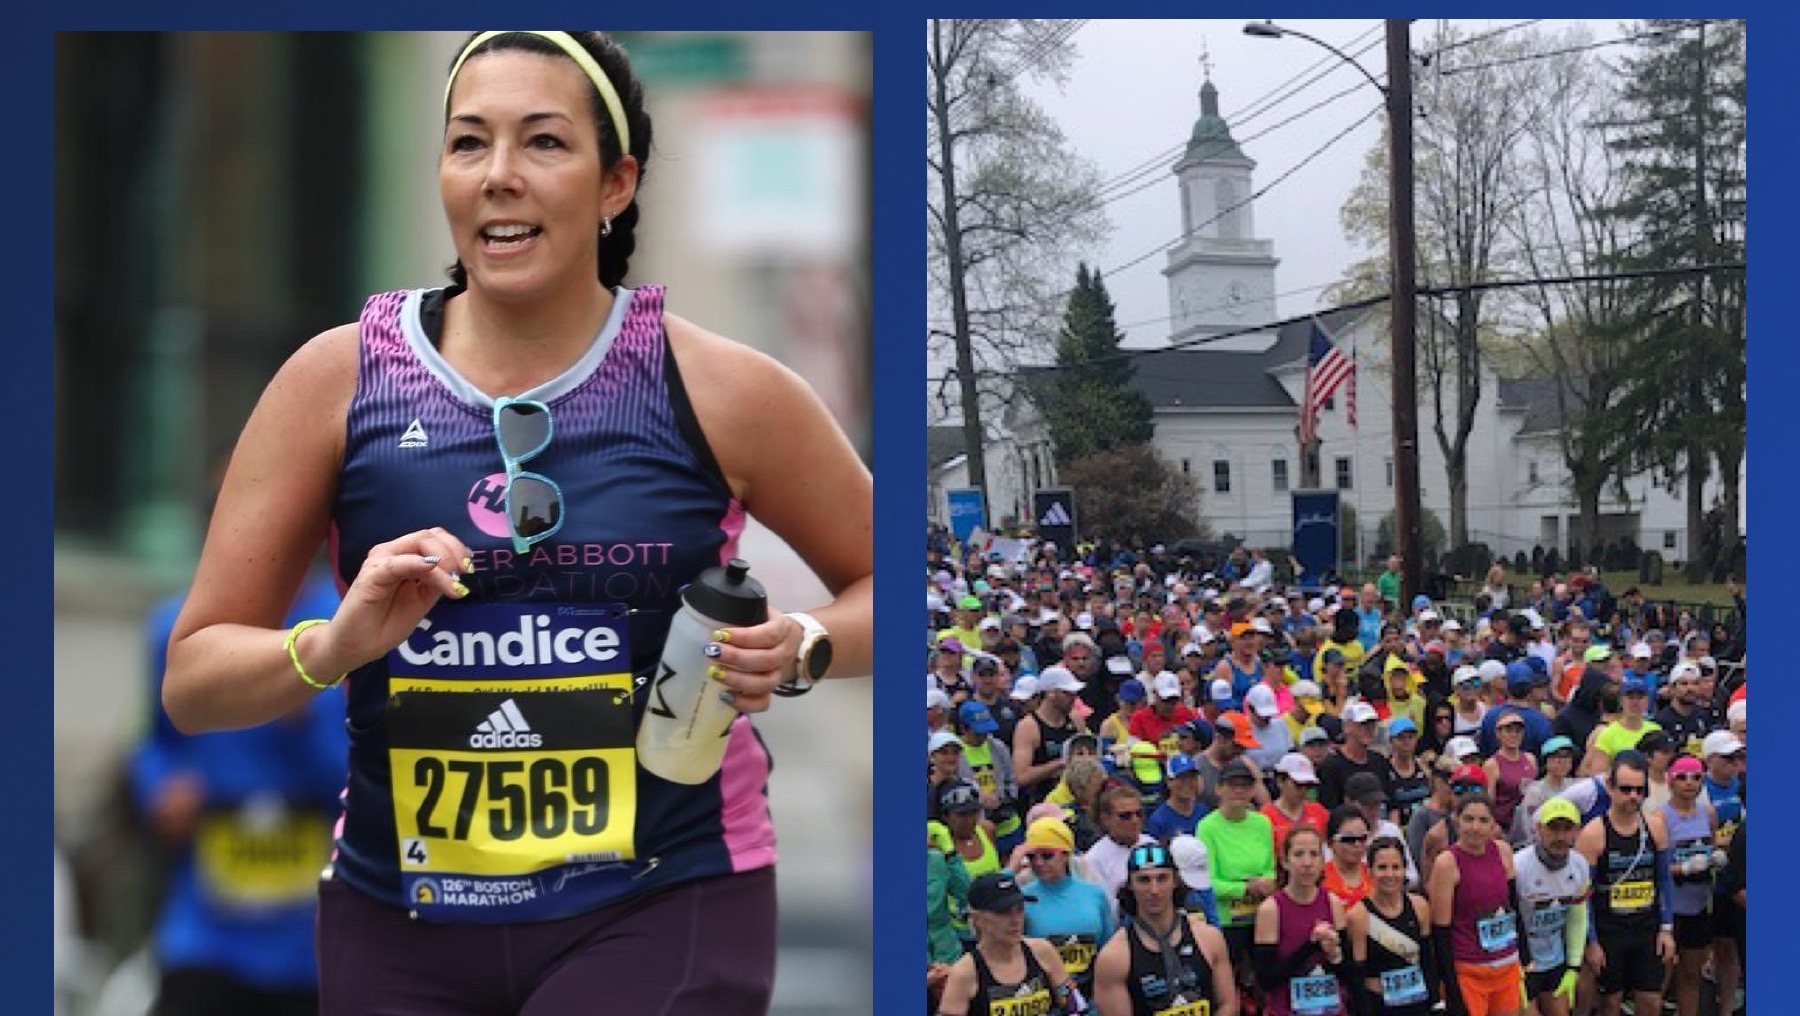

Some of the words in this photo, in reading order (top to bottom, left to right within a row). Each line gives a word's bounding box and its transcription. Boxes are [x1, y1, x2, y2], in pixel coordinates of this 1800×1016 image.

[529, 543, 674, 567] ABBOTT
[397, 614, 620, 666] Candice
[470, 731, 543, 748] adidas
[414, 757, 610, 841] 27569
[407, 841, 426, 864] 4
[443, 887, 538, 907] MARATHON
[474, 877, 533, 894] BOSTON
